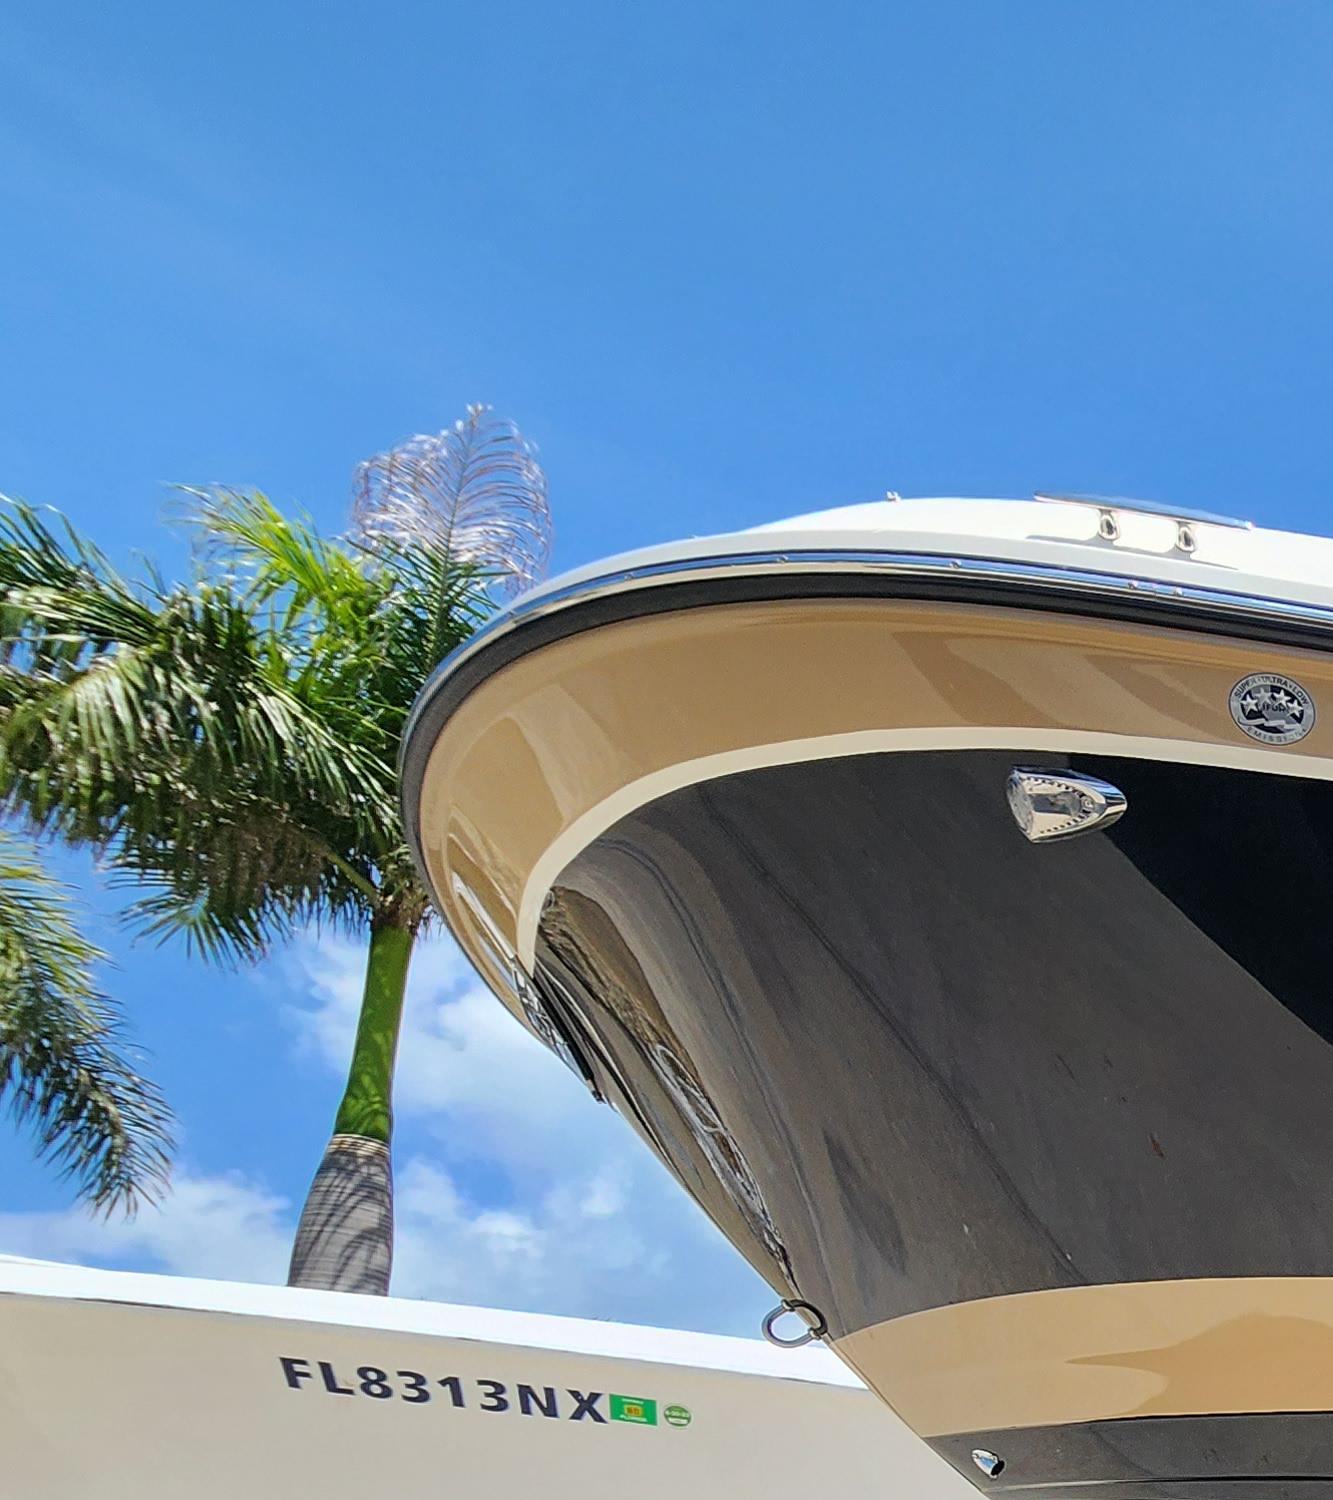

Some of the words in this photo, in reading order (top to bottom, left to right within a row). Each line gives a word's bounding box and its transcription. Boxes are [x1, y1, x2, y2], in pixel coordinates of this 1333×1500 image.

[1234, 678, 1257, 698] SUPER
[1261, 675, 1288, 688] ULTRA
[1292, 686, 1309, 705] LOW
[278, 1356, 609, 1424] FL8313NX
